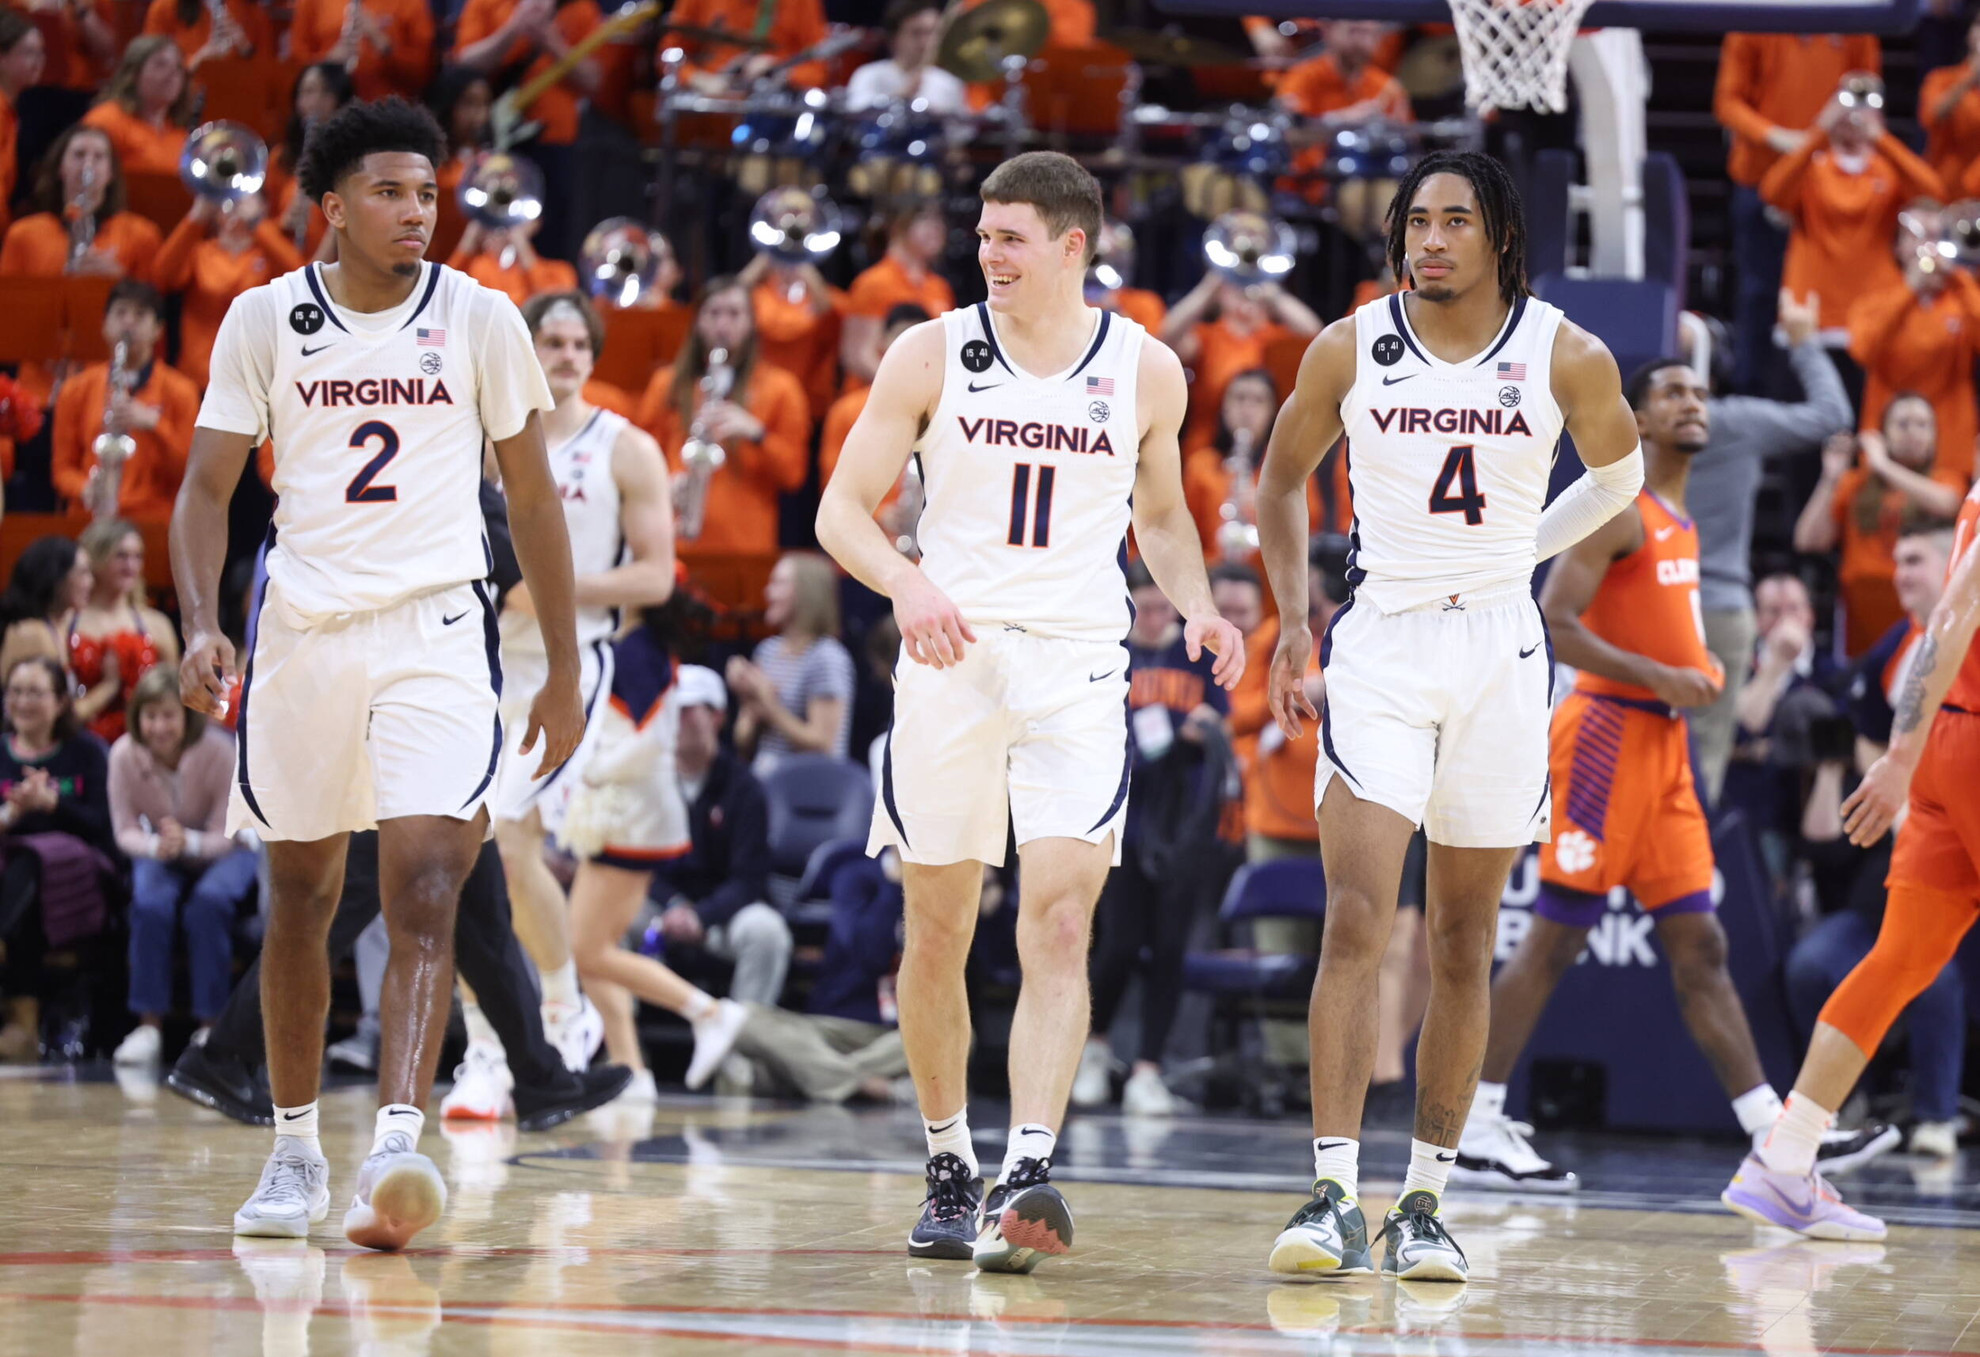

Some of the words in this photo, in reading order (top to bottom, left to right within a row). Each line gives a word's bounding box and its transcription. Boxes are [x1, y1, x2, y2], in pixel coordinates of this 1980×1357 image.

[966, 348, 974, 358] 15
[979, 348, 988, 357] 41
[1378, 342, 1386, 352] 15
[1390, 341, 1398, 350] 41
[295, 378, 454, 408] VIRGINIA
[957, 416, 1115, 457] VIRGINIA
[1369, 408, 1533, 437] VIRGINIA
[345, 420, 400, 504] 2
[1428, 444, 1487, 527] 4
[1007, 462, 1056, 548] 11
